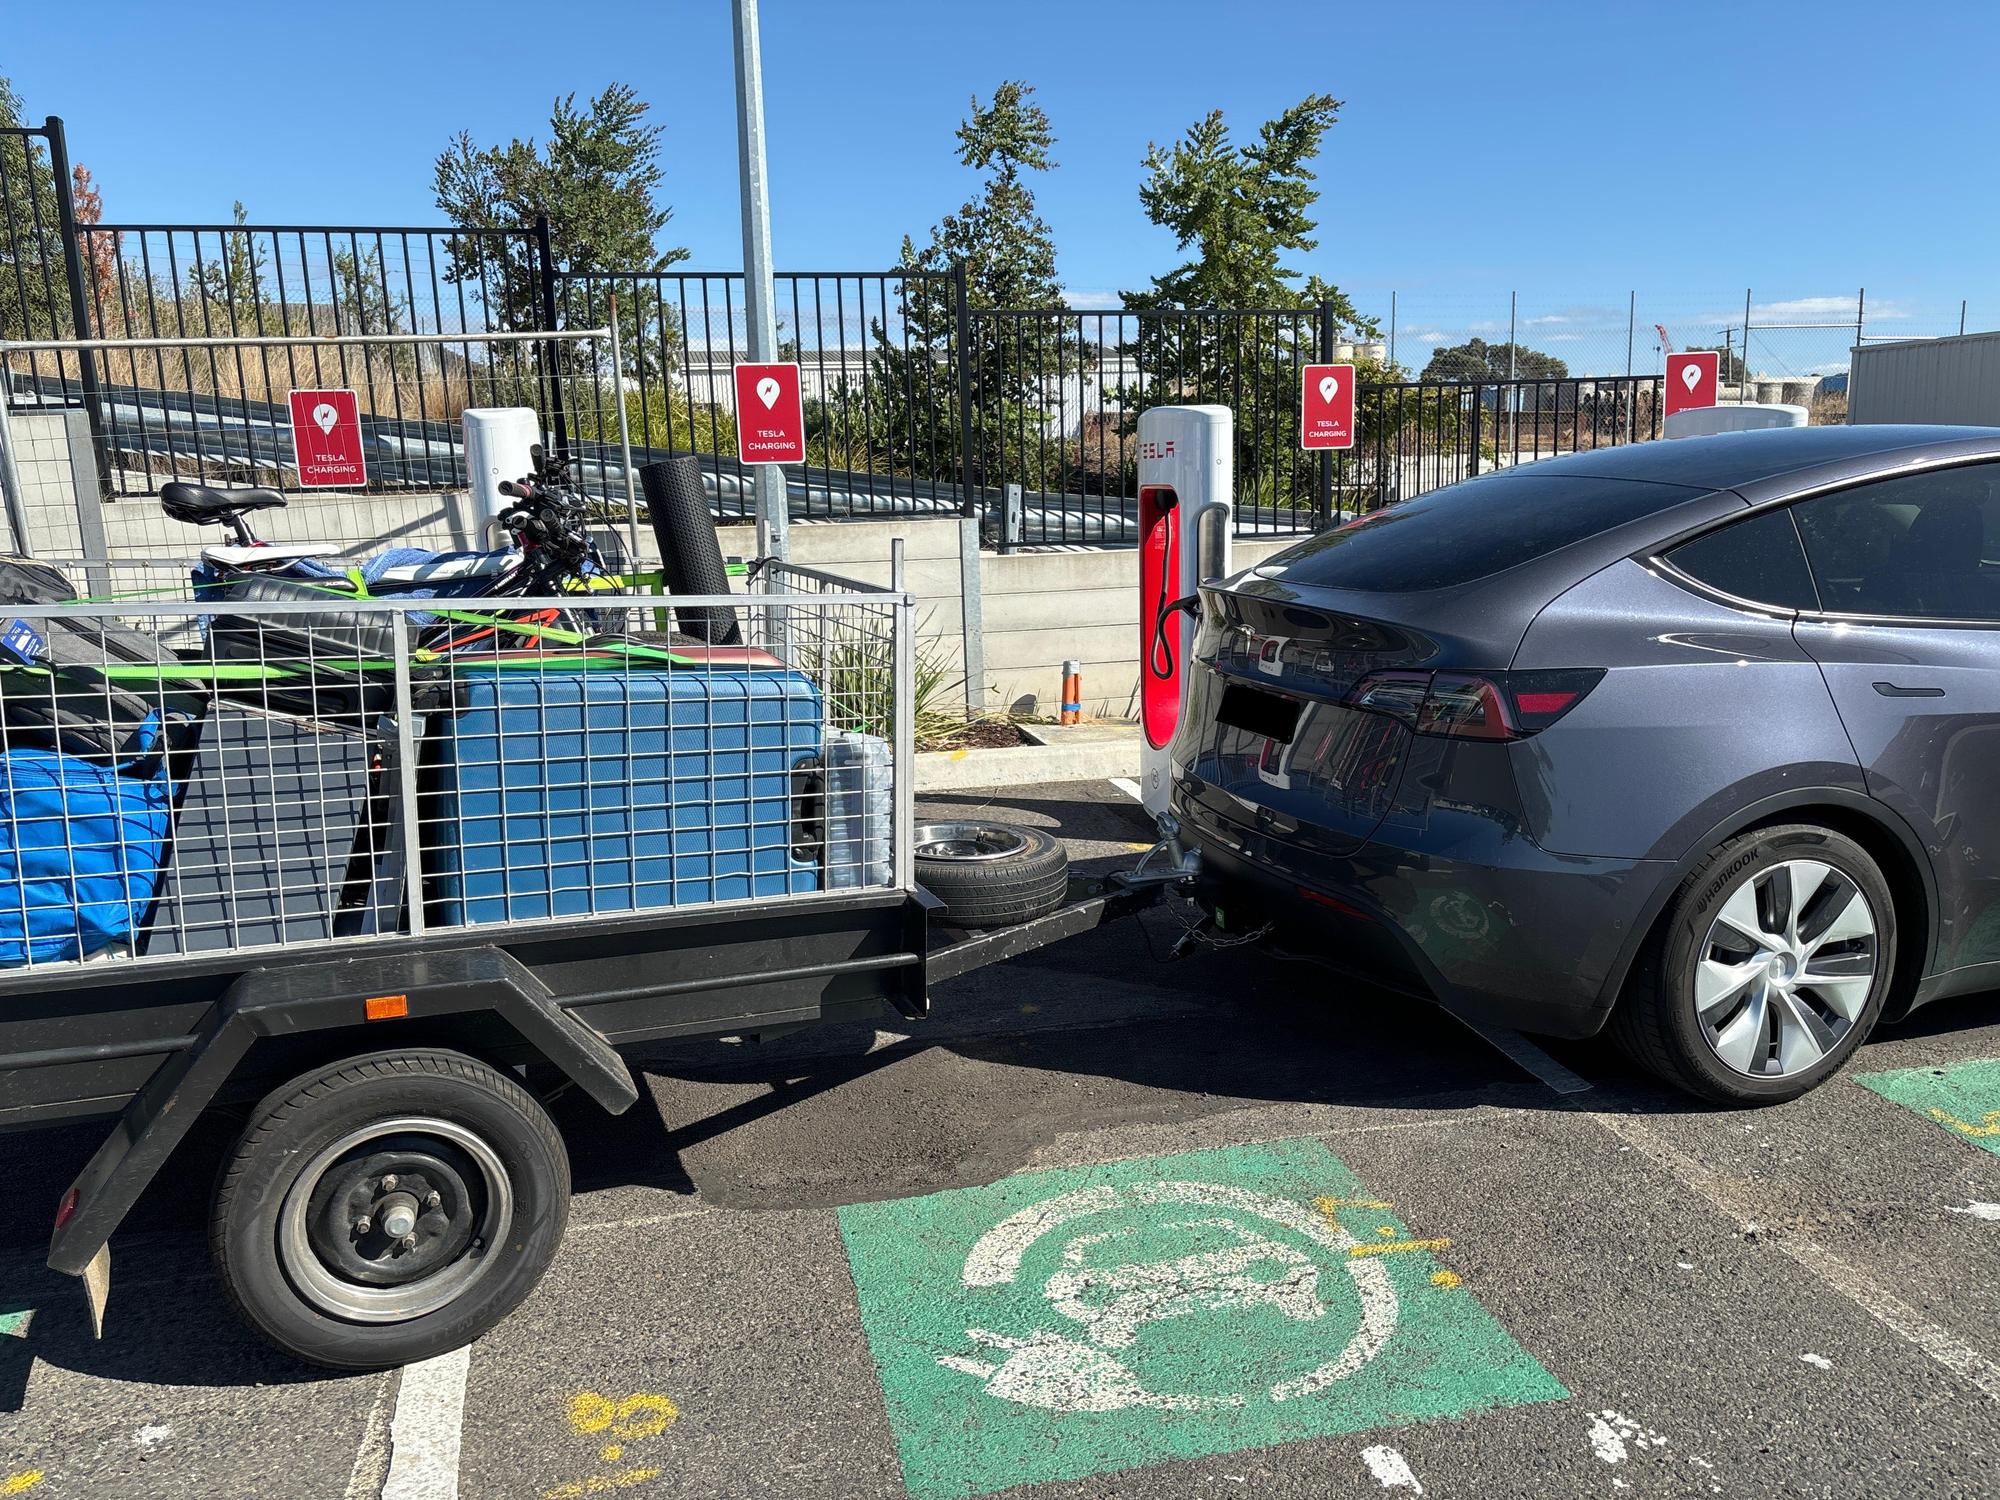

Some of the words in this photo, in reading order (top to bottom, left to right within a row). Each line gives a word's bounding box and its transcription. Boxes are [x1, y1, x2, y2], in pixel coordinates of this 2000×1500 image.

[757, 430, 785, 438] TESLA
[1308, 430, 1347, 438] CHARGING
[748, 442, 796, 450] CHARGING
[316, 454, 345, 462] TESLA
[307, 465, 356, 474] CHARGING
